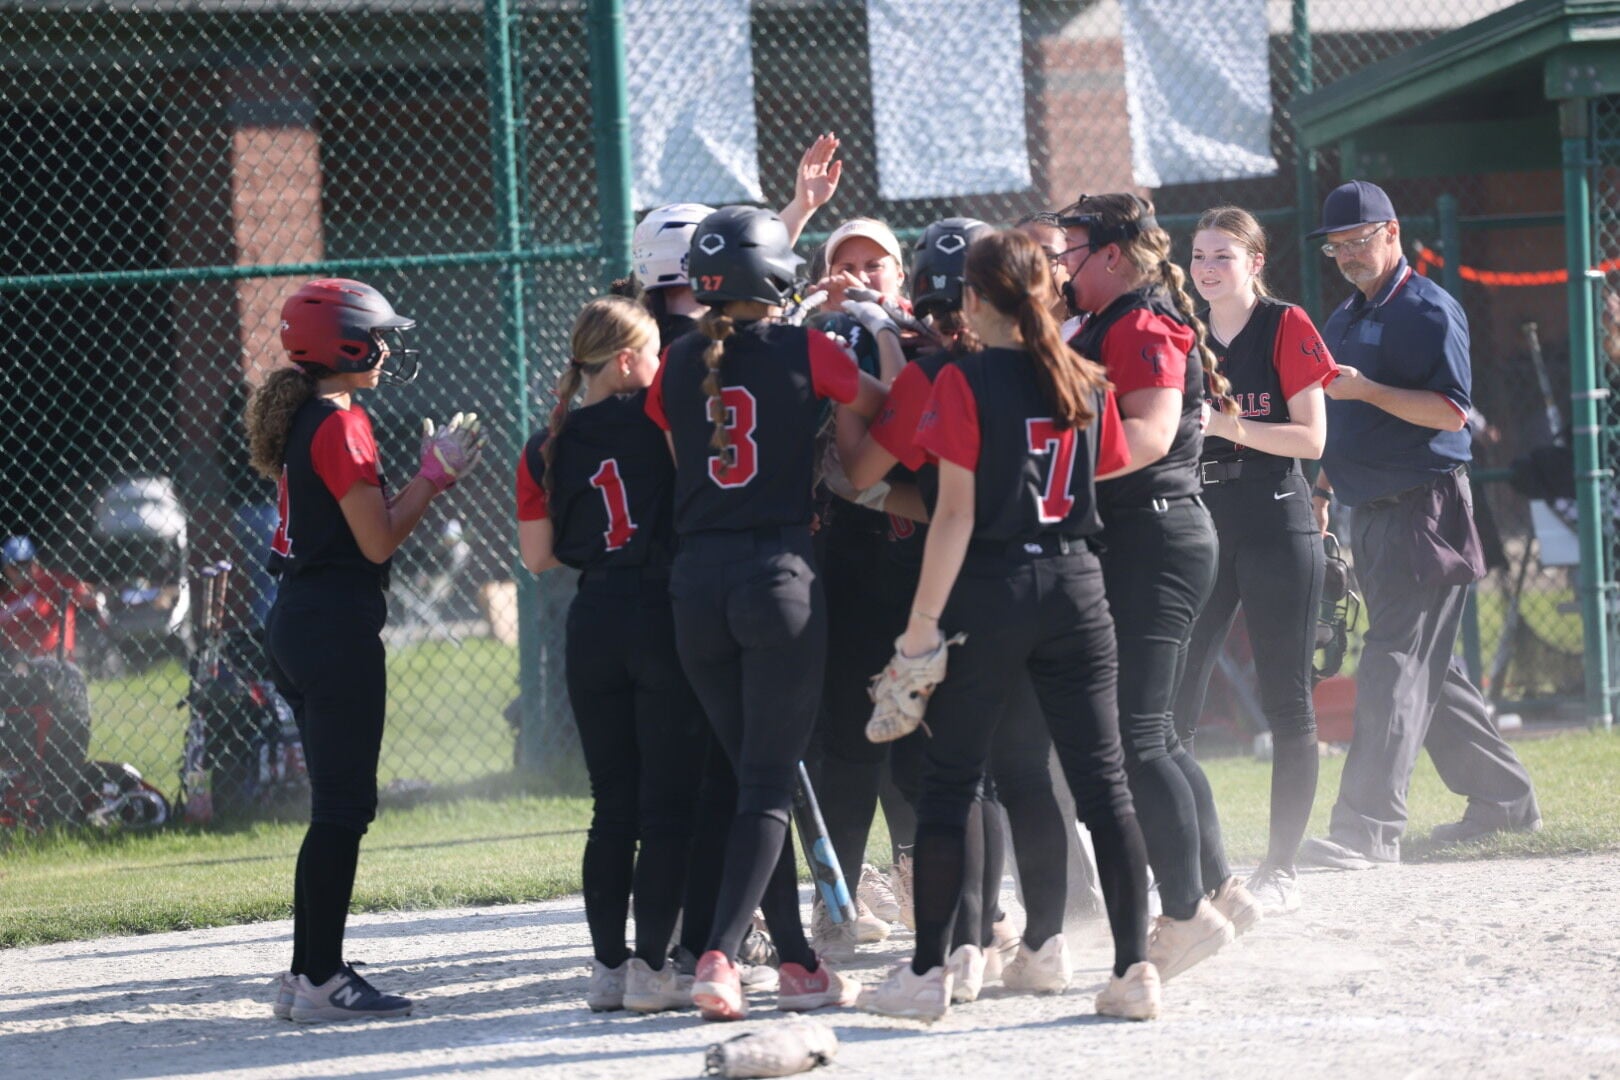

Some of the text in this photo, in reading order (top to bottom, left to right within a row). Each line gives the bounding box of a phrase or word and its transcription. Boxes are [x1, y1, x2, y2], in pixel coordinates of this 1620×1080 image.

[701, 274, 723, 291] 27
[706, 385, 758, 489] 3
[1025, 417, 1078, 523] 7
[589, 457, 638, 552] 1
